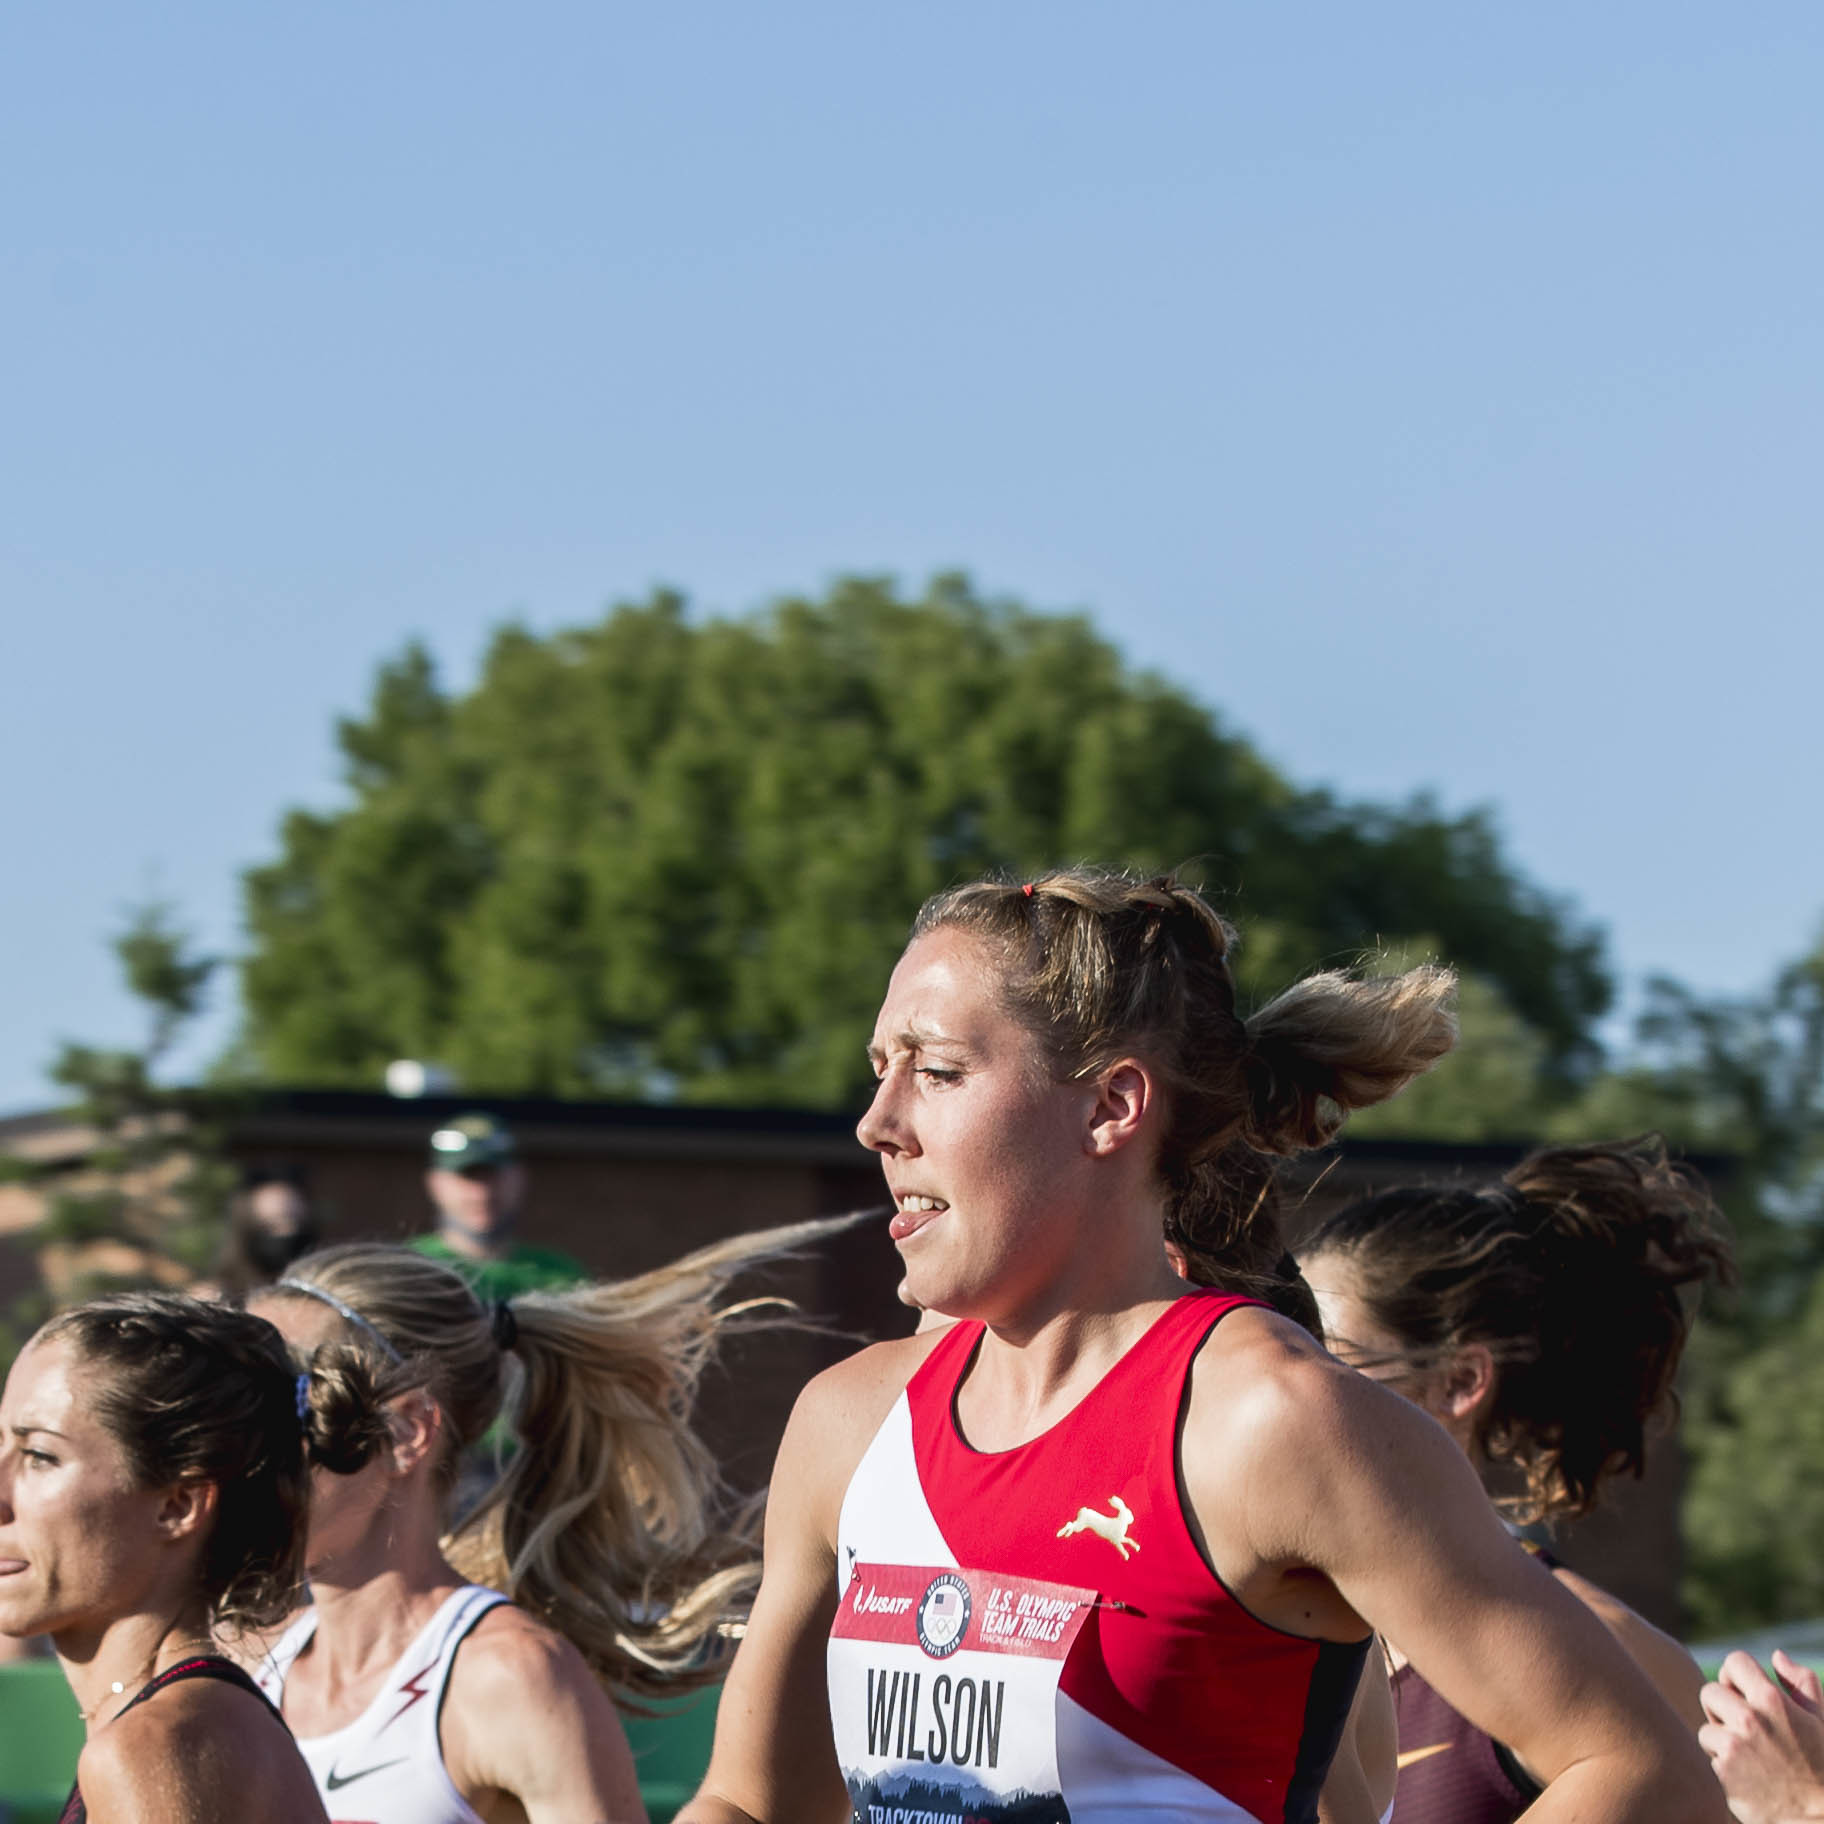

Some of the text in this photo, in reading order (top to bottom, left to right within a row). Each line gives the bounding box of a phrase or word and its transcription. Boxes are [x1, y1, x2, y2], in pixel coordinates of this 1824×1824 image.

[987, 1587, 1076, 1622] U.S. OLYMPIC
[981, 1609, 1065, 1643] TEAM TRIALS
[867, 1668, 1005, 1769] WILSON
